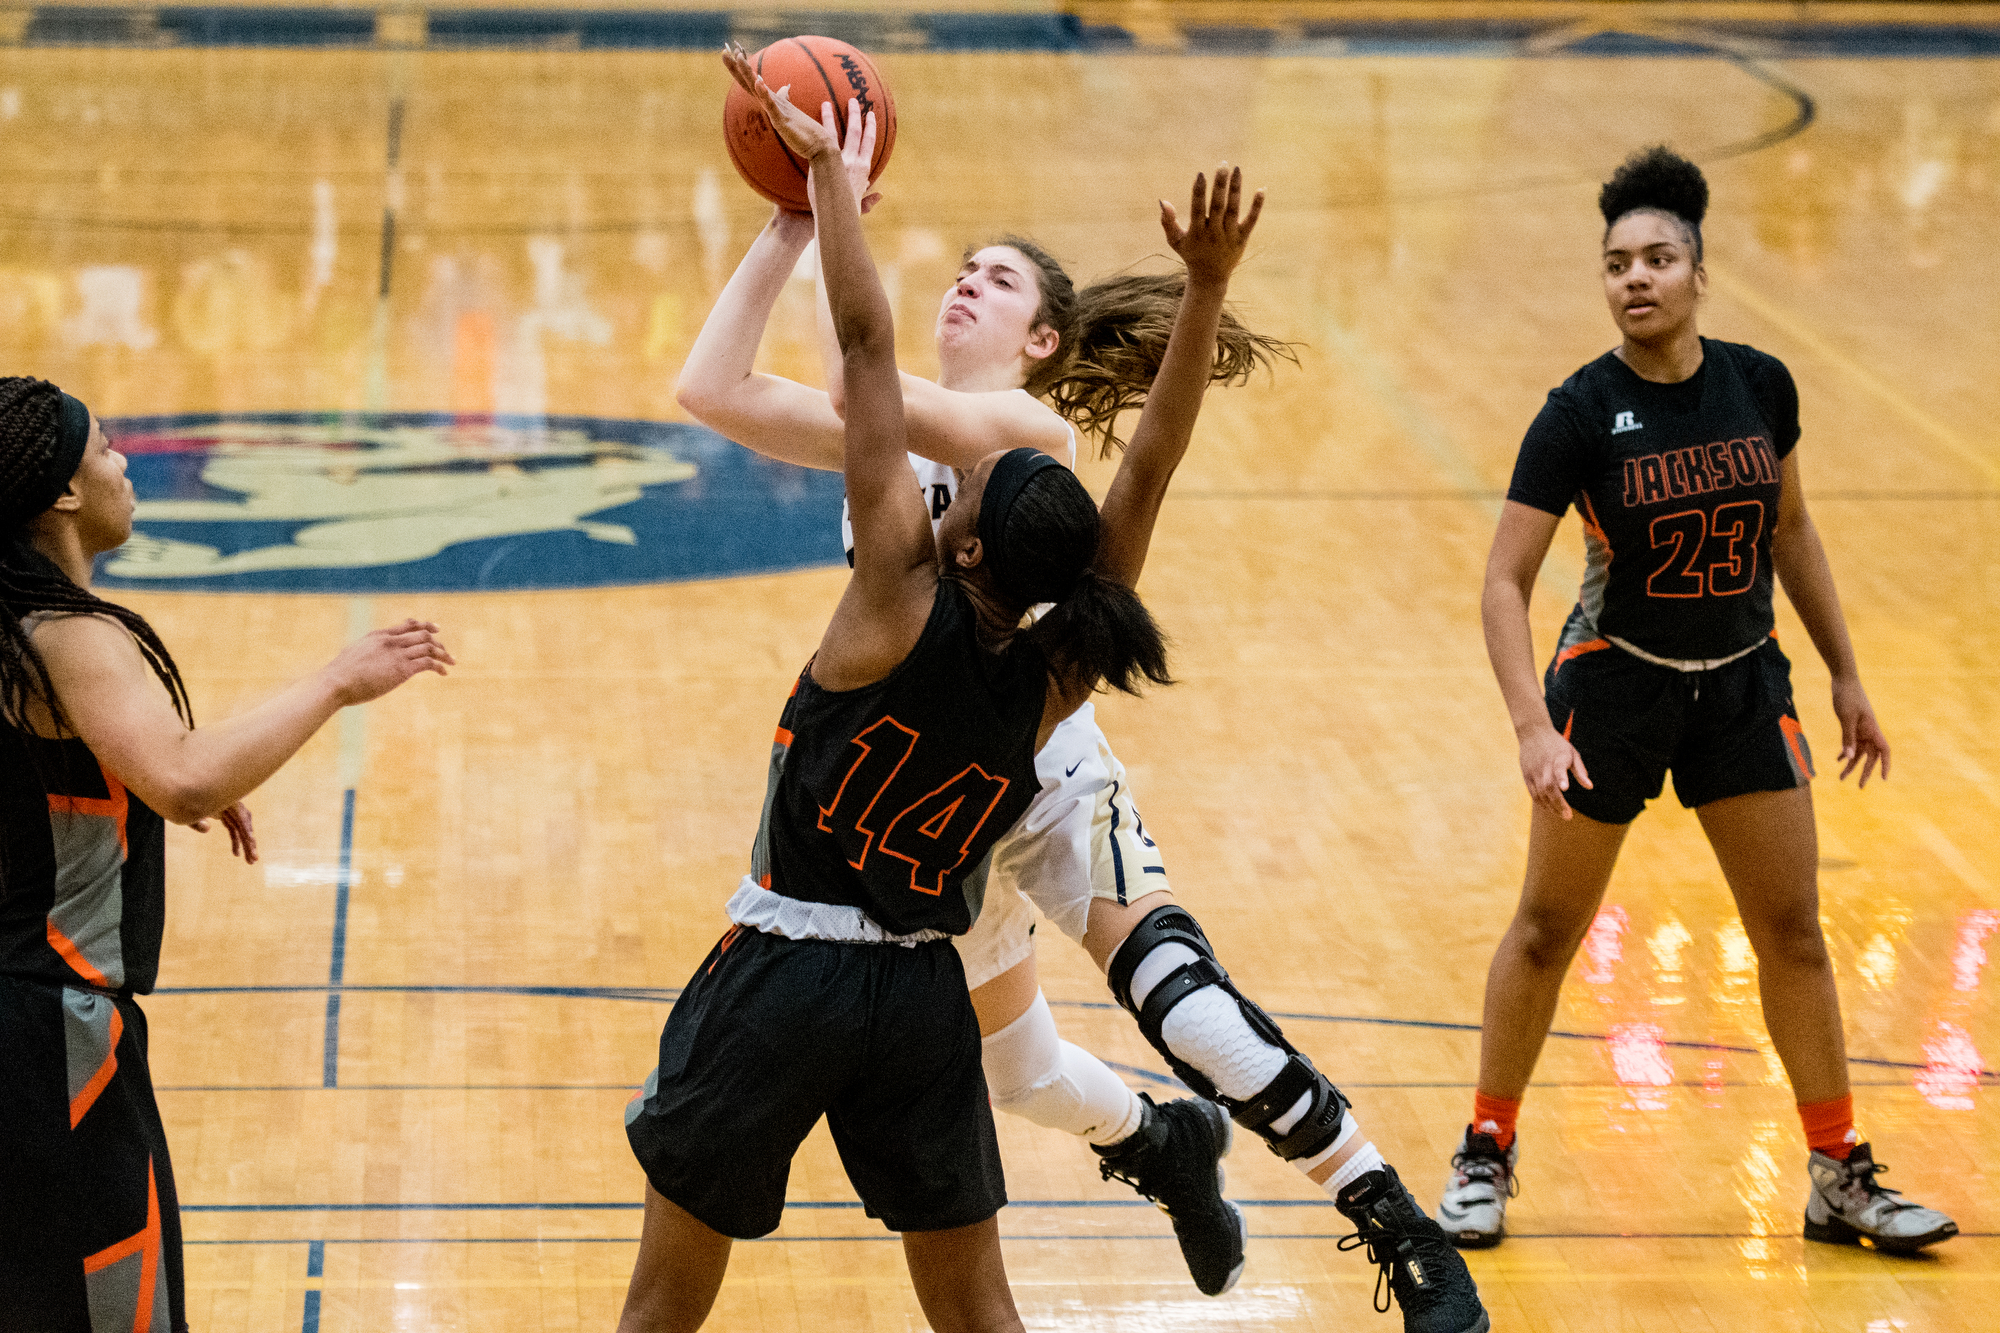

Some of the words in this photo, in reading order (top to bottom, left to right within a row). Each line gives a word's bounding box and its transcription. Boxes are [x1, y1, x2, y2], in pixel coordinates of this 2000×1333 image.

[1622, 436, 1780, 508] JACKSON
[1646, 499, 1765, 599] 23
[816, 714, 1012, 897] 14
